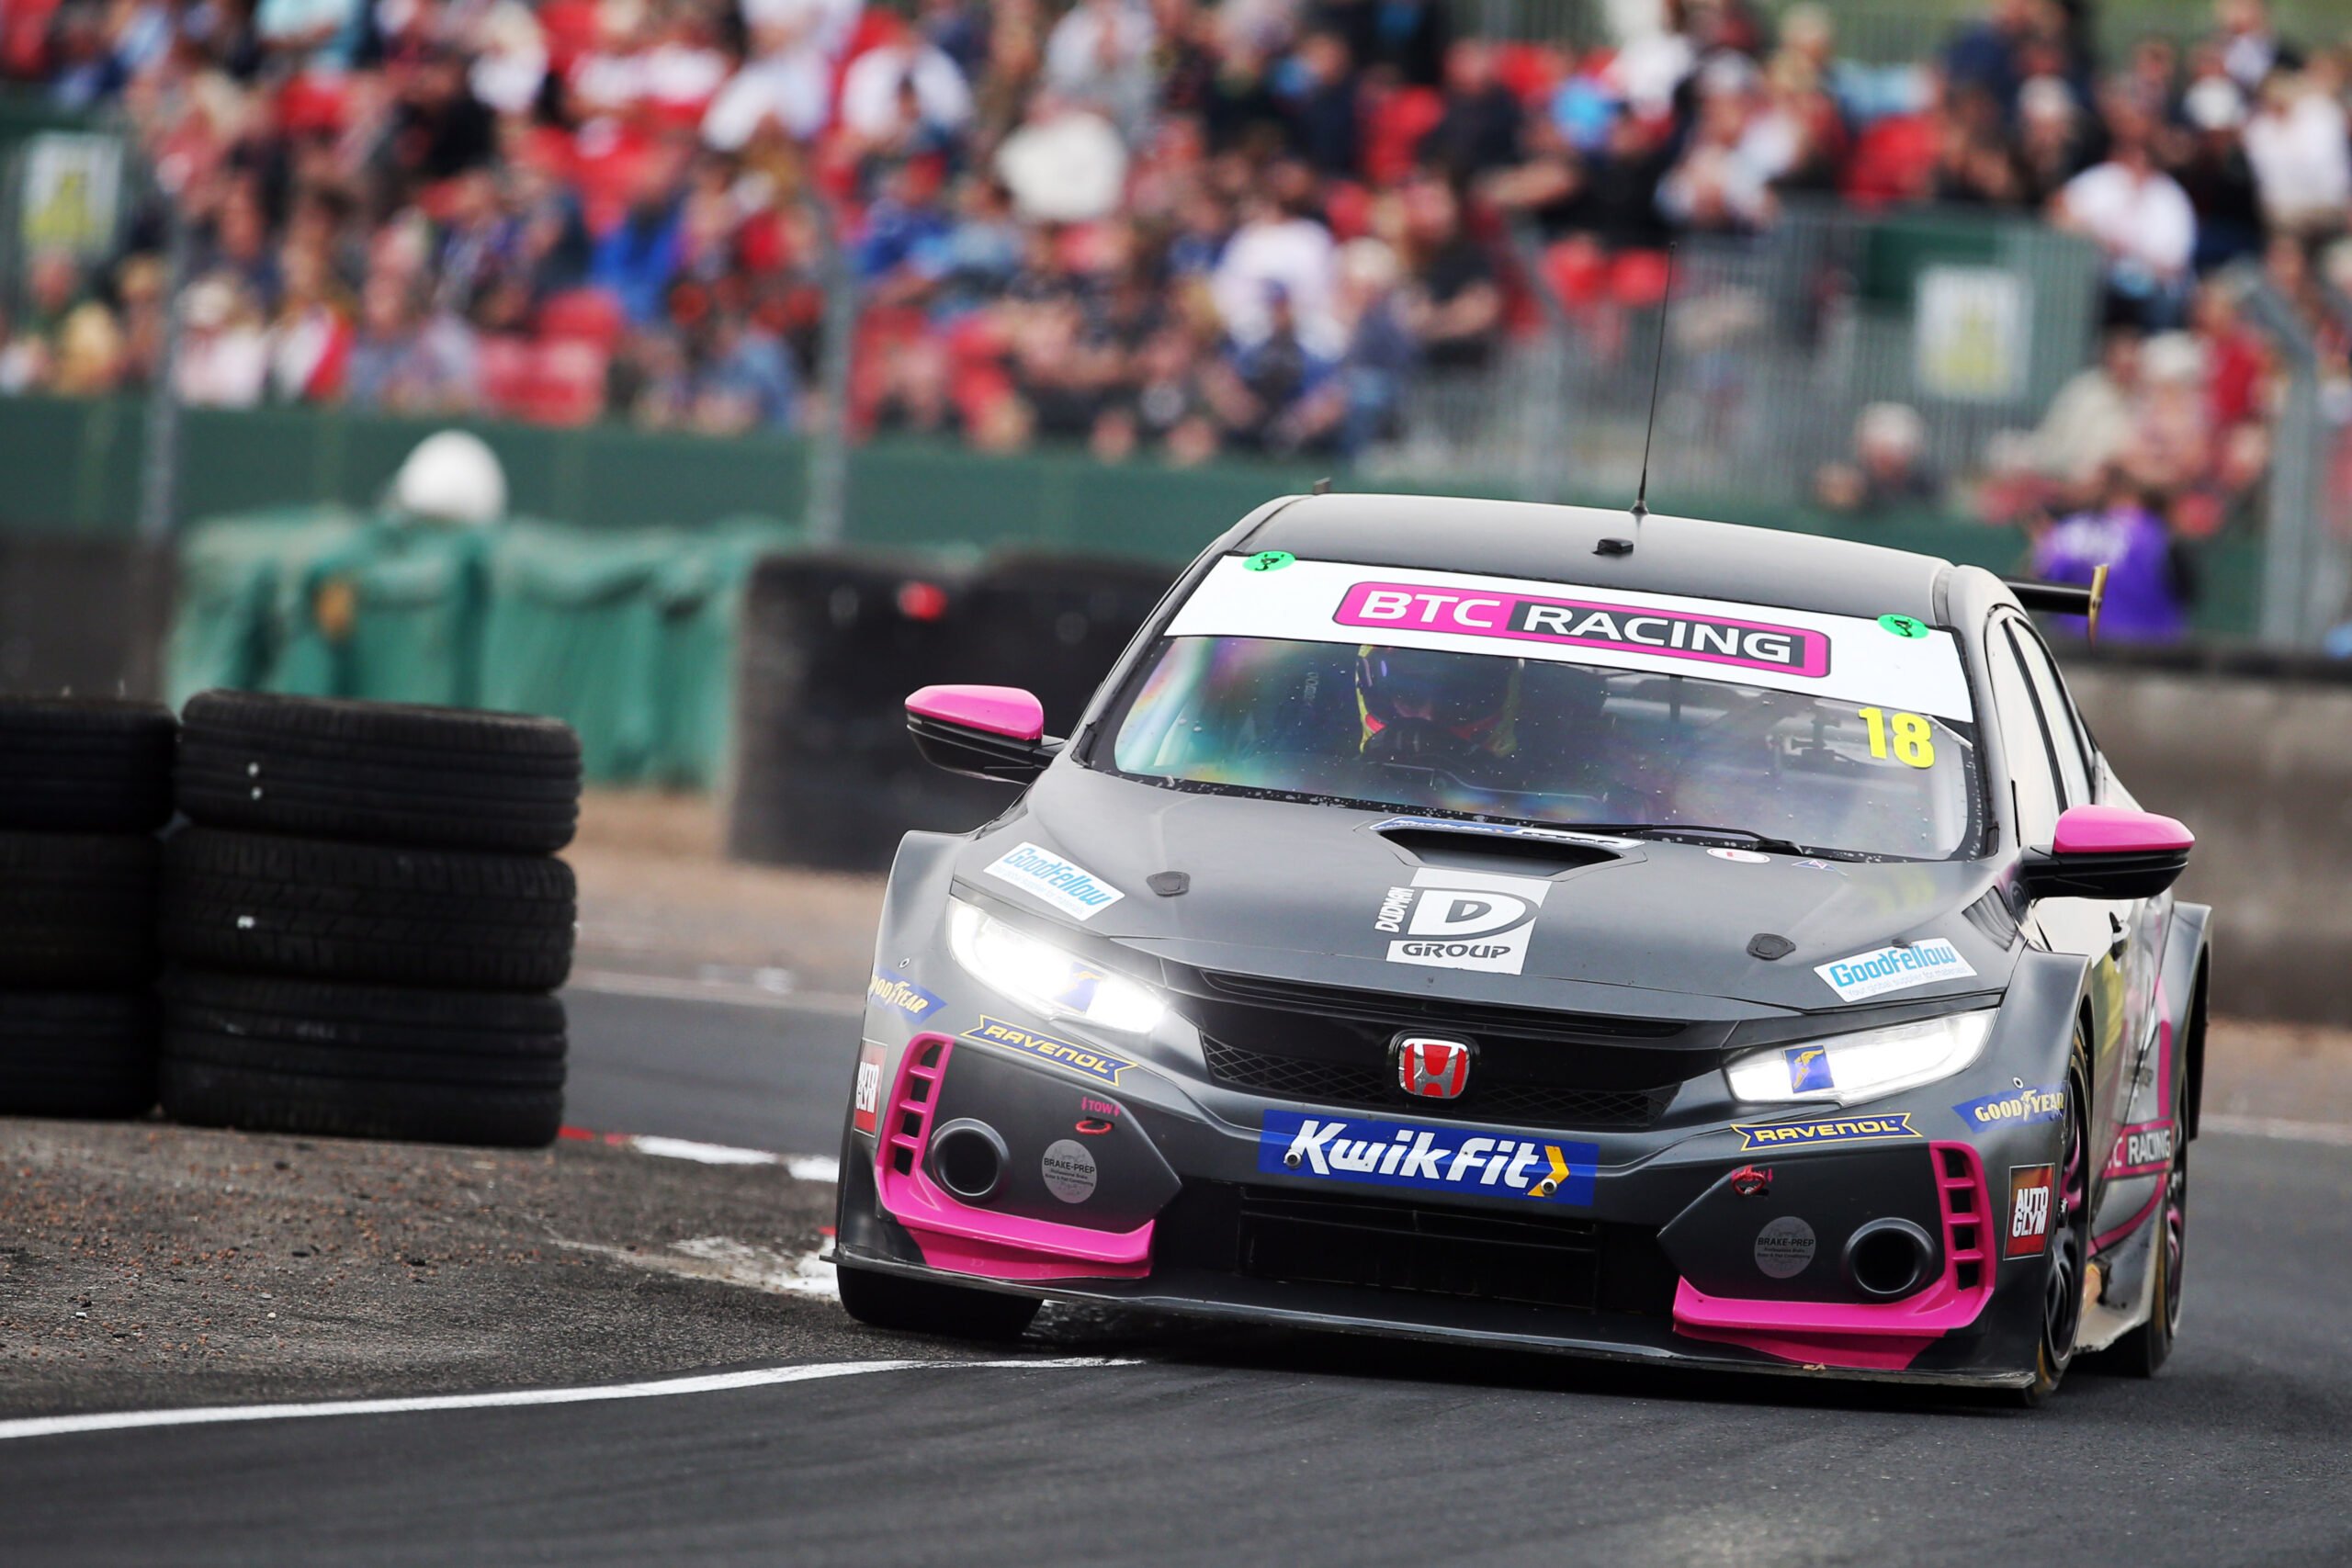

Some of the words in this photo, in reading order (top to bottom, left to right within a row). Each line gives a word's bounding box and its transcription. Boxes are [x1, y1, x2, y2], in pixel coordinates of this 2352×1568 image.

[1358, 591, 1500, 628] BTC
[1523, 604, 1792, 664] RACING
[1858, 706, 1935, 769] 18
[1374, 886, 1415, 933] DUDMAN
[1401, 942, 1511, 959] GROUP
[1829, 944, 1957, 987] GoodFellow
[983, 1024, 1110, 1074] RAVENOL
[1088, 1100, 1113, 1114] TOW
[1974, 1089, 2064, 1122] GOODYEAR
[1753, 1121, 1900, 1142] RAVENOL
[1044, 1157, 1095, 1175] BRAKE-PREP
[2014, 1186, 2049, 1213] AUTO
[2012, 1211, 2047, 1237] GLYM
[1757, 1236, 1815, 1247] BRAKE-PREP
